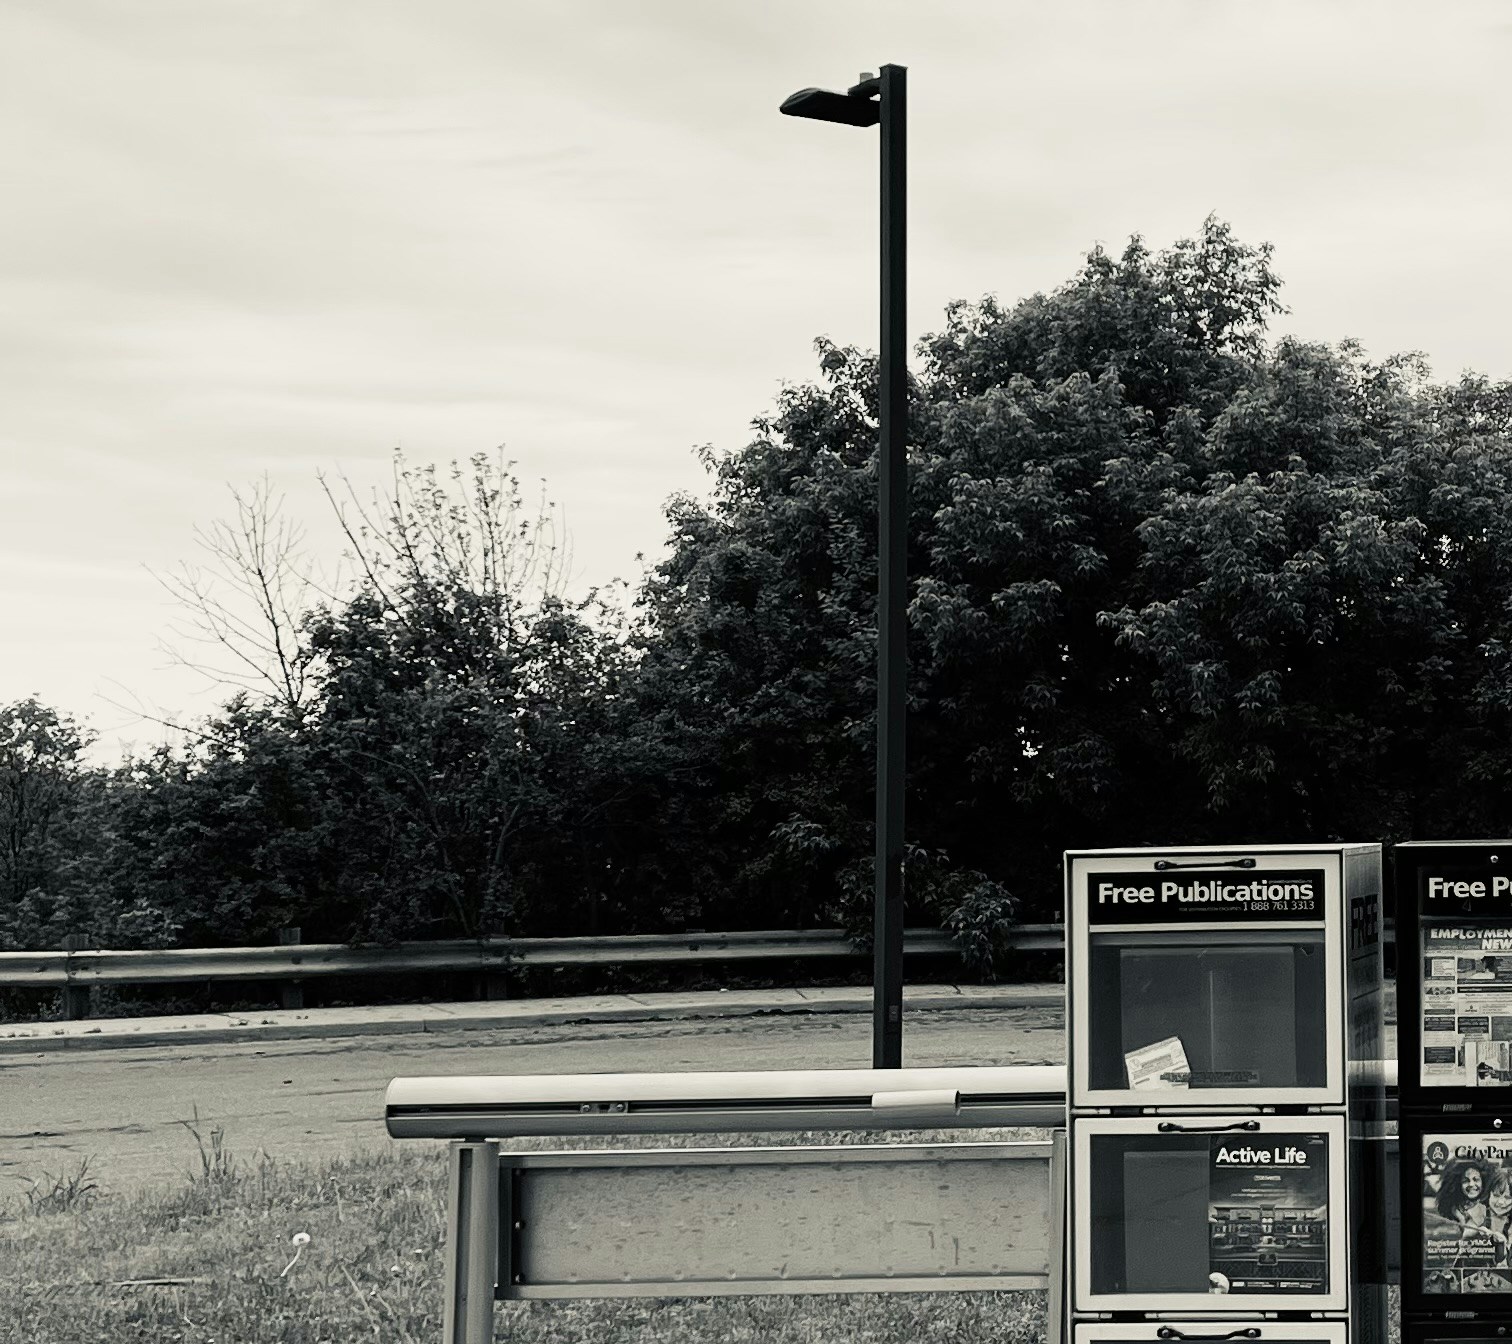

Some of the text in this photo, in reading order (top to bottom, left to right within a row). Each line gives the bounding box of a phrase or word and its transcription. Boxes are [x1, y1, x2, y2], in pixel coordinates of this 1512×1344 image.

[1099, 879, 1314, 904] Free Publications
[1428, 877, 1485, 898] Free
[1242, 901, 1248, 911] 1
[1250, 901, 1270, 911] 888
[1272, 900, 1289, 911] 761
[1291, 900, 1315, 910] 3313
[1216, 1145, 1307, 1164] Active Life
